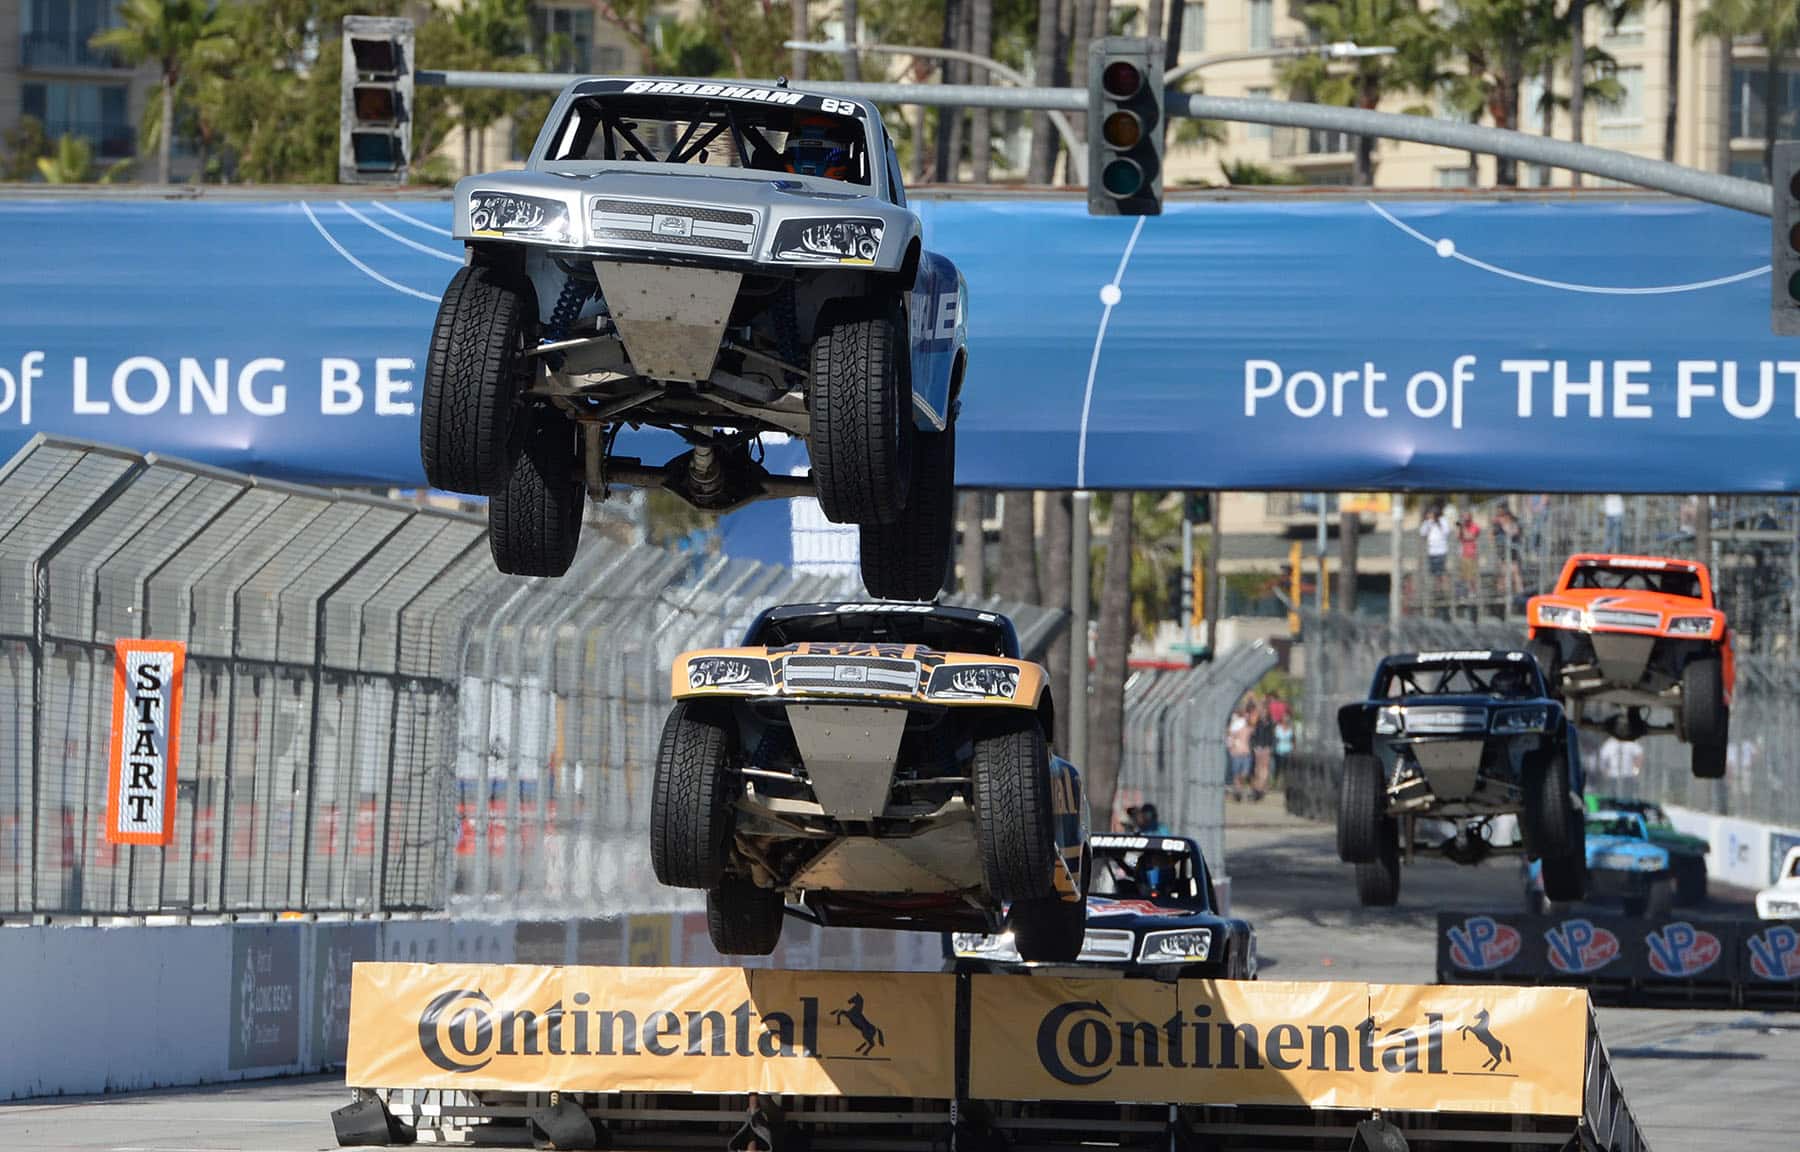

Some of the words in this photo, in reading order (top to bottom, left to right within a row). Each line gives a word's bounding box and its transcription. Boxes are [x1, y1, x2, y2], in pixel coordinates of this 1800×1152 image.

[623, 81, 804, 105] BRABHAM
[820, 98, 856, 116] 83
[73, 356, 287, 416] LONG
[321, 358, 415, 416] BE
[1245, 360, 1388, 418] Port
[1406, 355, 1476, 429] of
[1501, 360, 1652, 418] THE
[128, 664, 161, 822] START
[418, 988, 822, 1074] Continental
[1036, 1000, 1448, 1085] Continental
